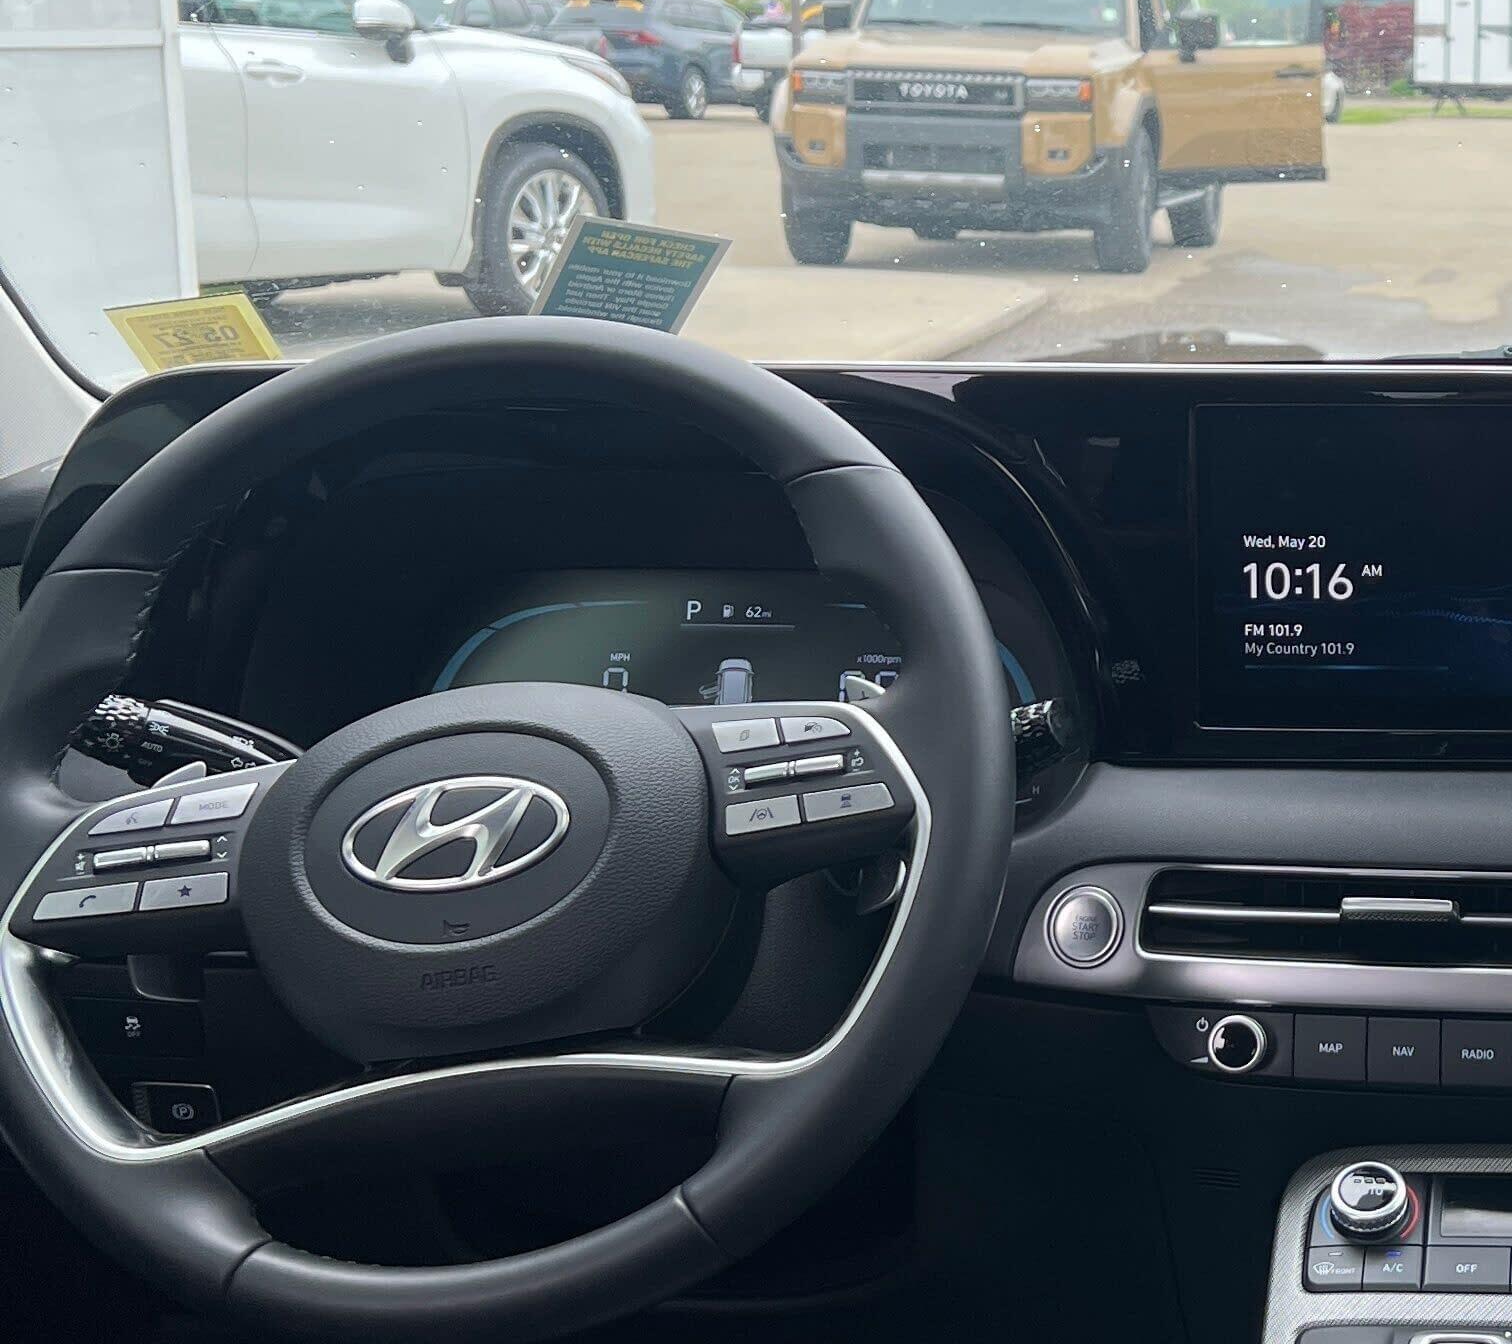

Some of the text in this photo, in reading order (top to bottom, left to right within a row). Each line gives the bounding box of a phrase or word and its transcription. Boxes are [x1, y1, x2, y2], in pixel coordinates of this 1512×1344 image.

[899, 83, 969, 99] TOYOTA
[1243, 535, 1326, 551] Wed, May 20
[1361, 564, 1383, 577] AM
[1243, 561, 1354, 600] 10:16
[686, 600, 702, 620] P
[1244, 623, 1303, 637] FM 101.9
[1244, 642, 1355, 658] My Country 101.9
[610, 653, 631, 662] MPH
[141, 741, 163, 753] AUTO
[727, 776, 741, 784] OK
[1072, 922, 1099, 932] START
[1072, 931, 1096, 941] STOP
[421, 965, 499, 991] AIRBAG
[1319, 1042, 1343, 1053] MAP
[1392, 1045, 1415, 1057] NAV
[1461, 1049, 1494, 1060] RADIO
[1331, 1267, 1356, 1275] FRONT
[1382, 1263, 1404, 1273] A/C
[1456, 1263, 1478, 1273] OFF
